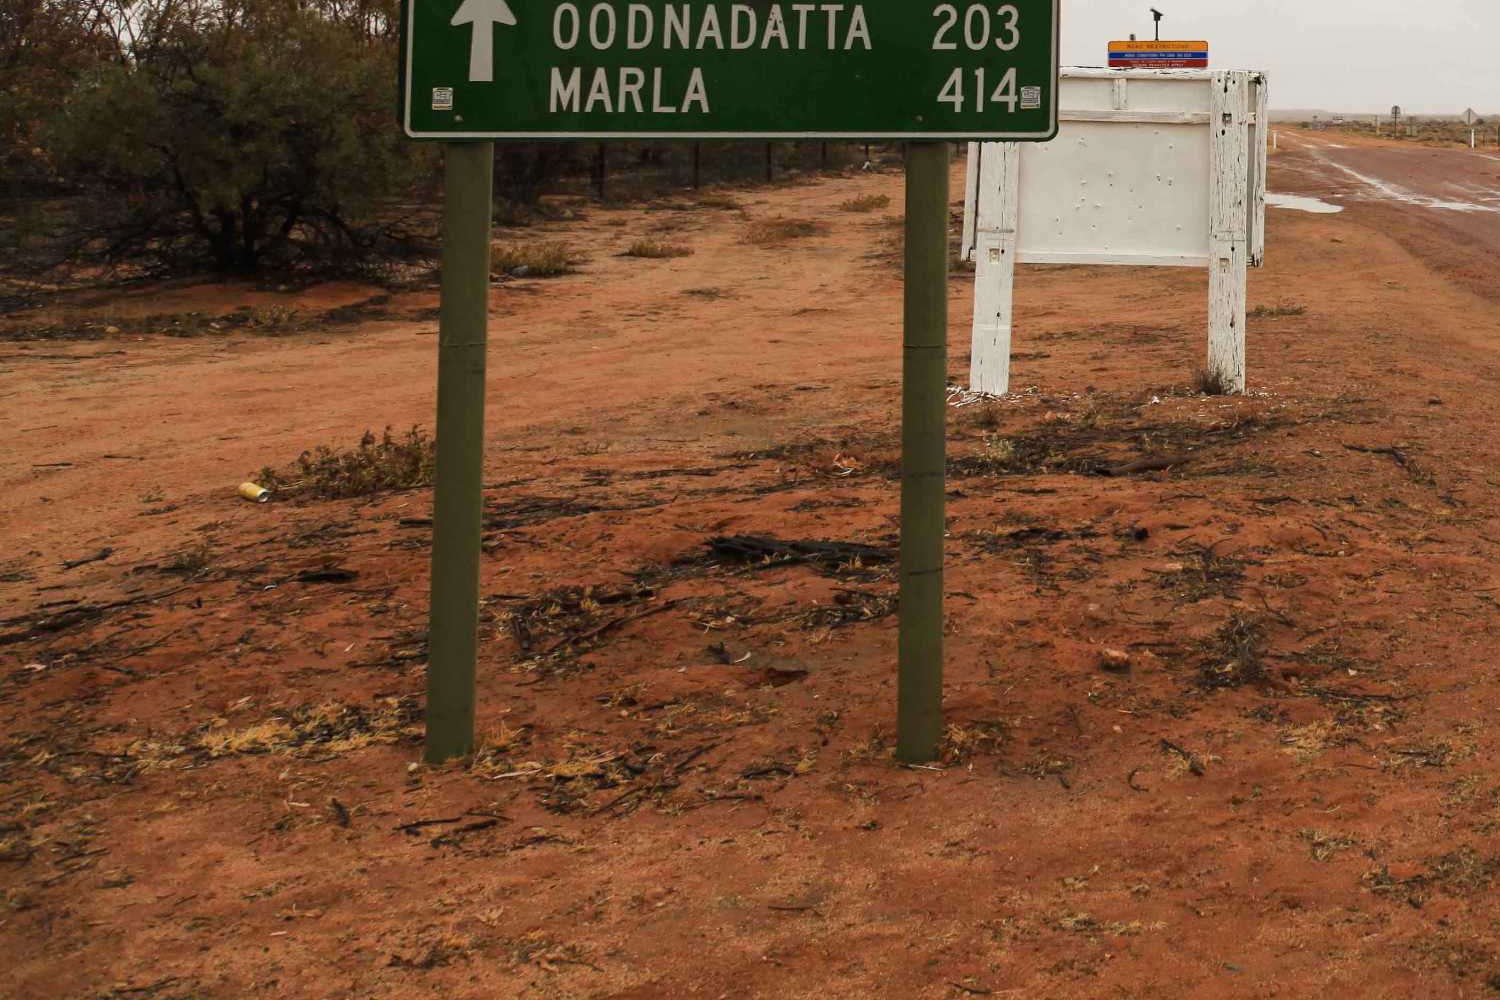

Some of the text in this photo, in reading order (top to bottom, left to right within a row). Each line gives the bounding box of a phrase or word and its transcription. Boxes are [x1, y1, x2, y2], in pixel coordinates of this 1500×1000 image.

[554, 3, 1019, 50] OODNADATTA 203
[550, 67, 709, 113] MARLA
[938, 67, 1018, 113] 414
